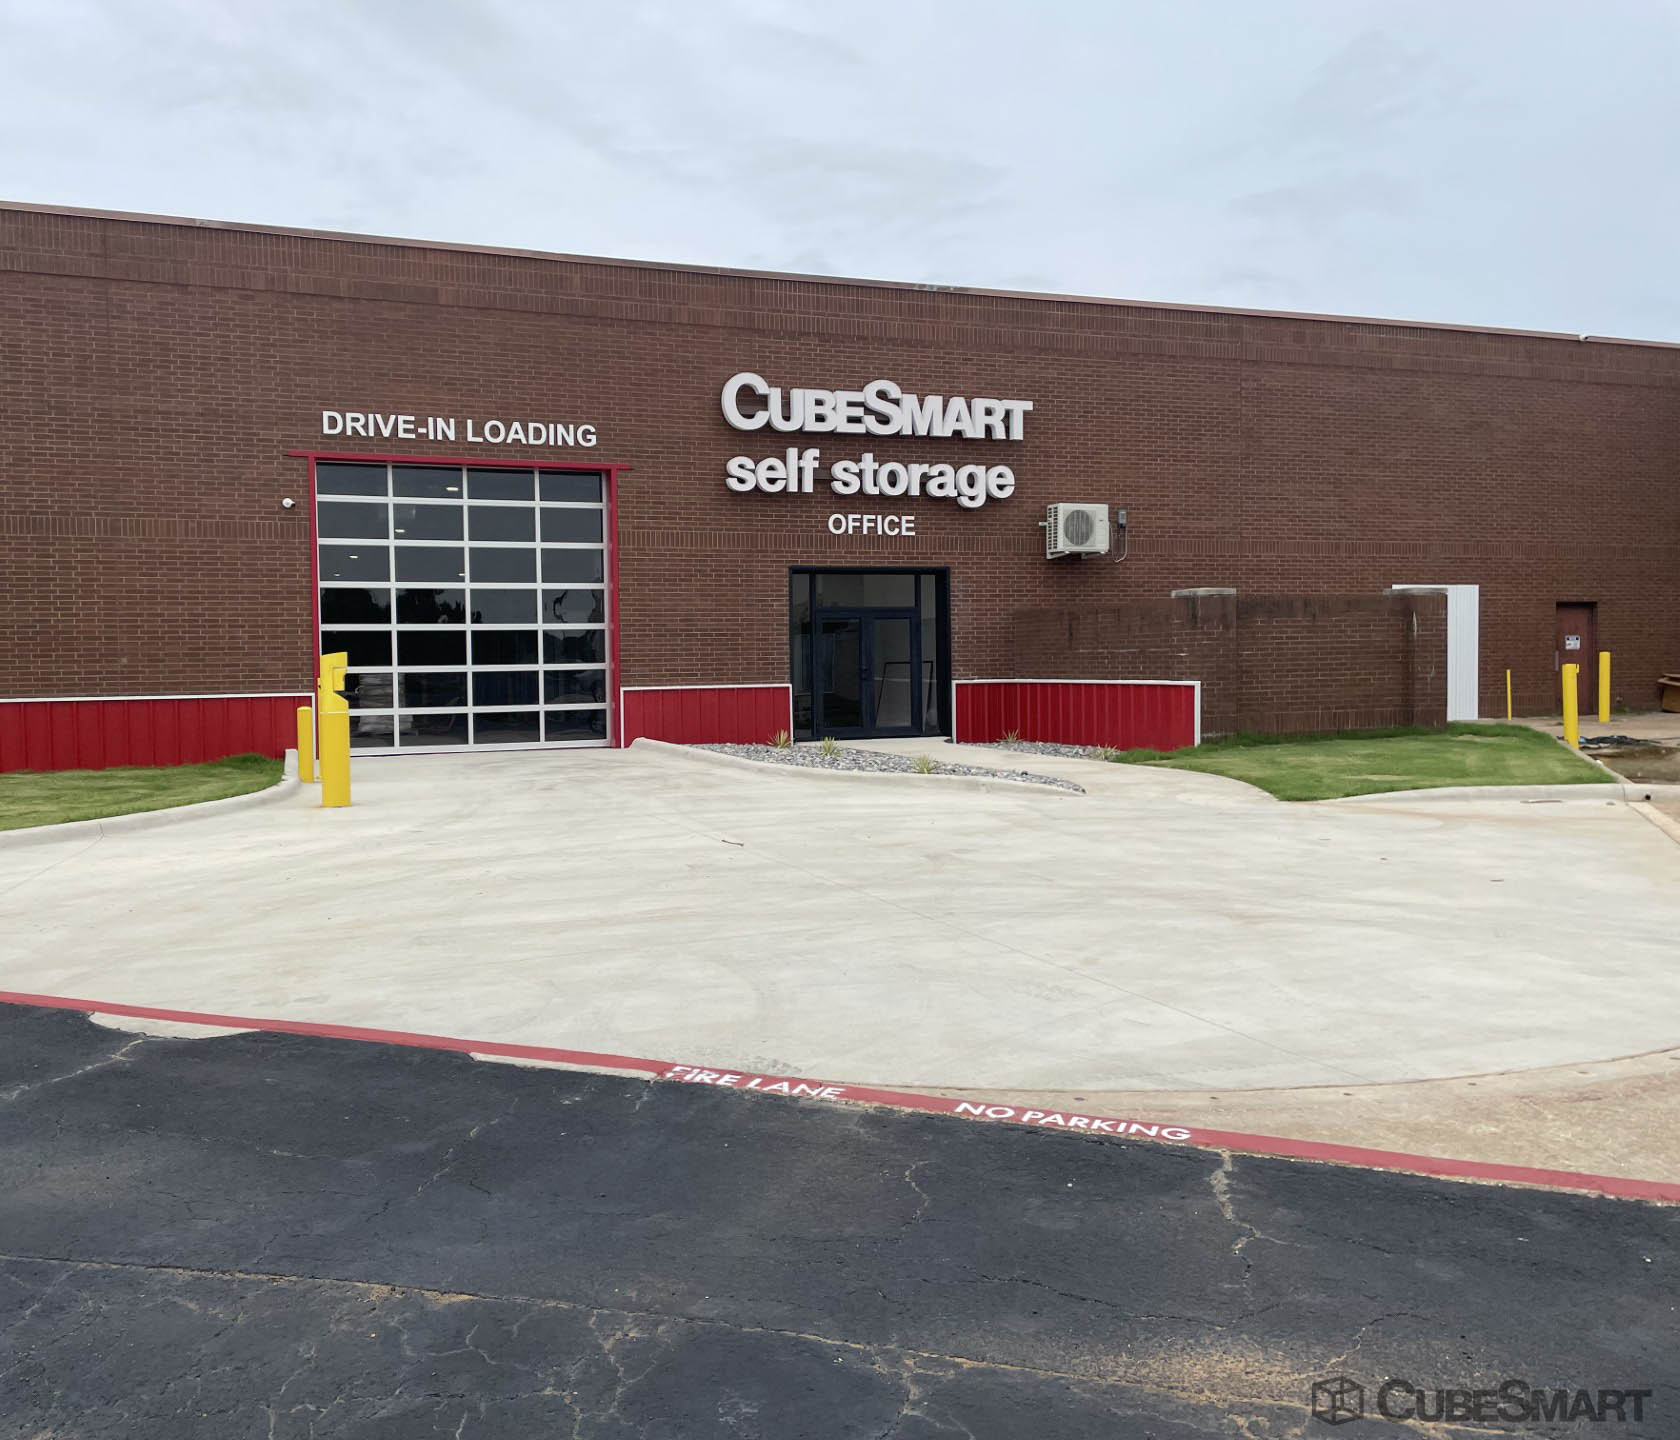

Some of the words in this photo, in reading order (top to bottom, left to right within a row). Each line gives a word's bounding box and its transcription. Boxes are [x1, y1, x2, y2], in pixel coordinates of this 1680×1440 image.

[322, 410, 457, 441] DRIVE-IN
[466, 418, 598, 448] LOADING
[725, 447, 820, 493] self
[830, 452, 1016, 508] storage
[827, 513, 916, 536] OFFICE
[665, 1065, 742, 1087] FIRE
[745, 1077, 846, 1099] LANE
[953, 1101, 1016, 1120] NO
[1019, 1109, 1192, 1142] PARKING
